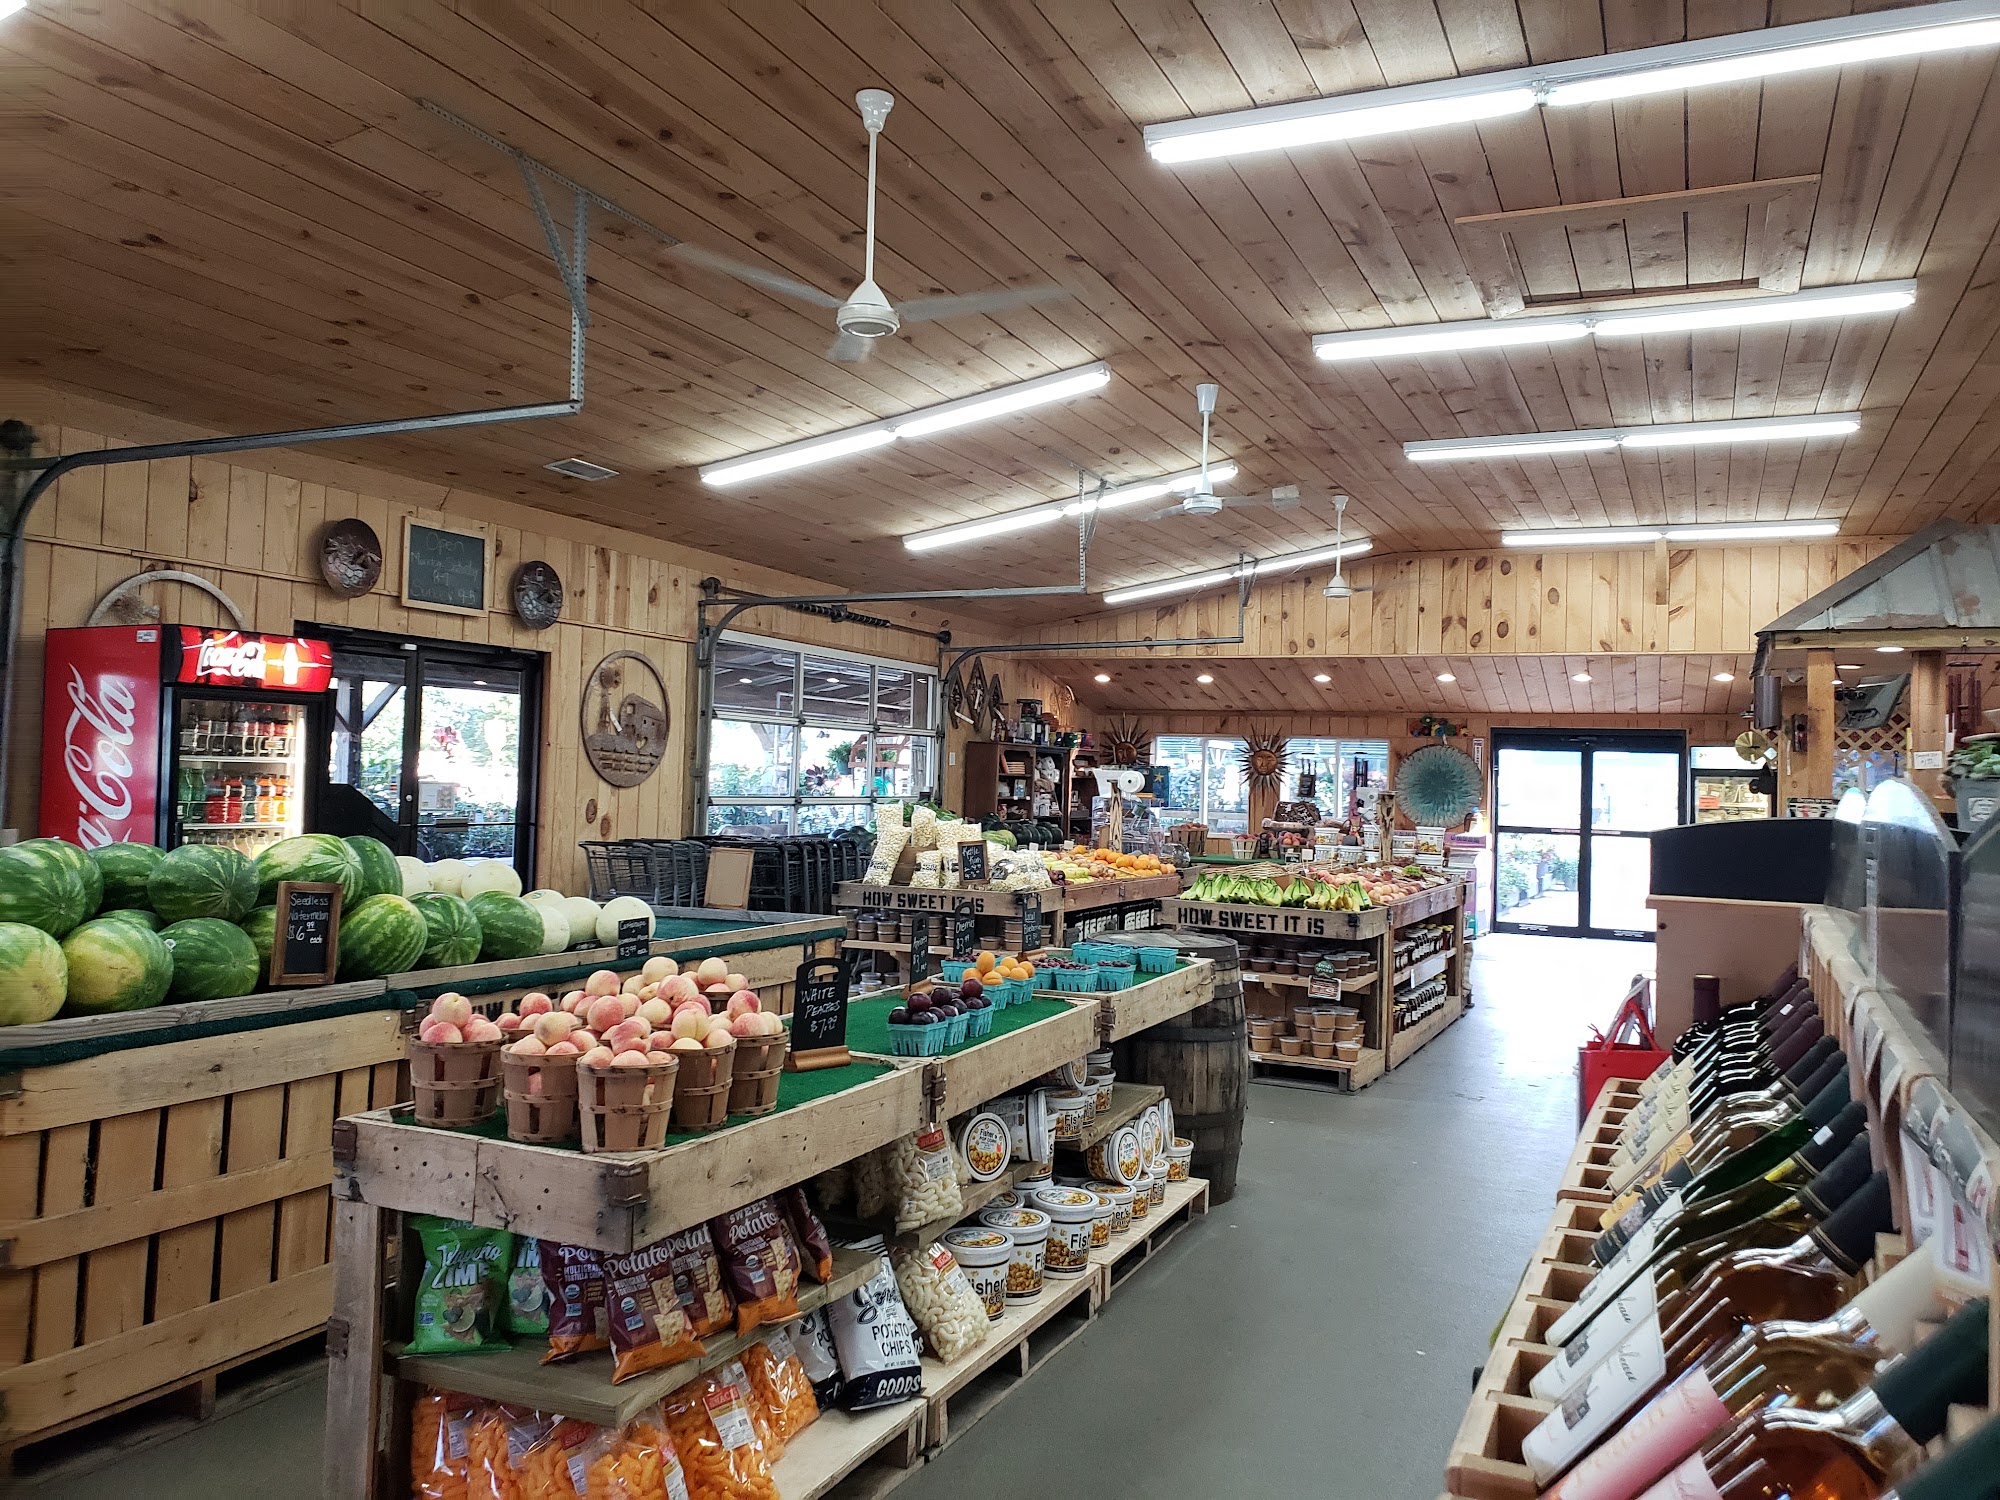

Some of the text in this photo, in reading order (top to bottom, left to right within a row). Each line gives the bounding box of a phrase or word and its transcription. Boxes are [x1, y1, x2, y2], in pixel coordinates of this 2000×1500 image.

[426, 532, 465, 555] Open
[290, 893, 329, 906] Seedless
[863, 891, 893, 907] HOW
[898, 892, 947, 910] SWEET
[1178, 908, 1213, 926] HOW
[1219, 910, 1278, 931] SWEET
[1284, 915, 1300, 933] IT
[801, 986, 836, 1004] WHITE
[729, 1200, 768, 1224] SWEET
[728, 1211, 779, 1245] Potato
[665, 1222, 714, 1258] Potat
[602, 1243, 673, 1279] Potato
[871, 1322, 910, 1341] POTATO
[881, 1338, 912, 1357] CHIPS
[876, 1374, 922, 1399] GOODS
